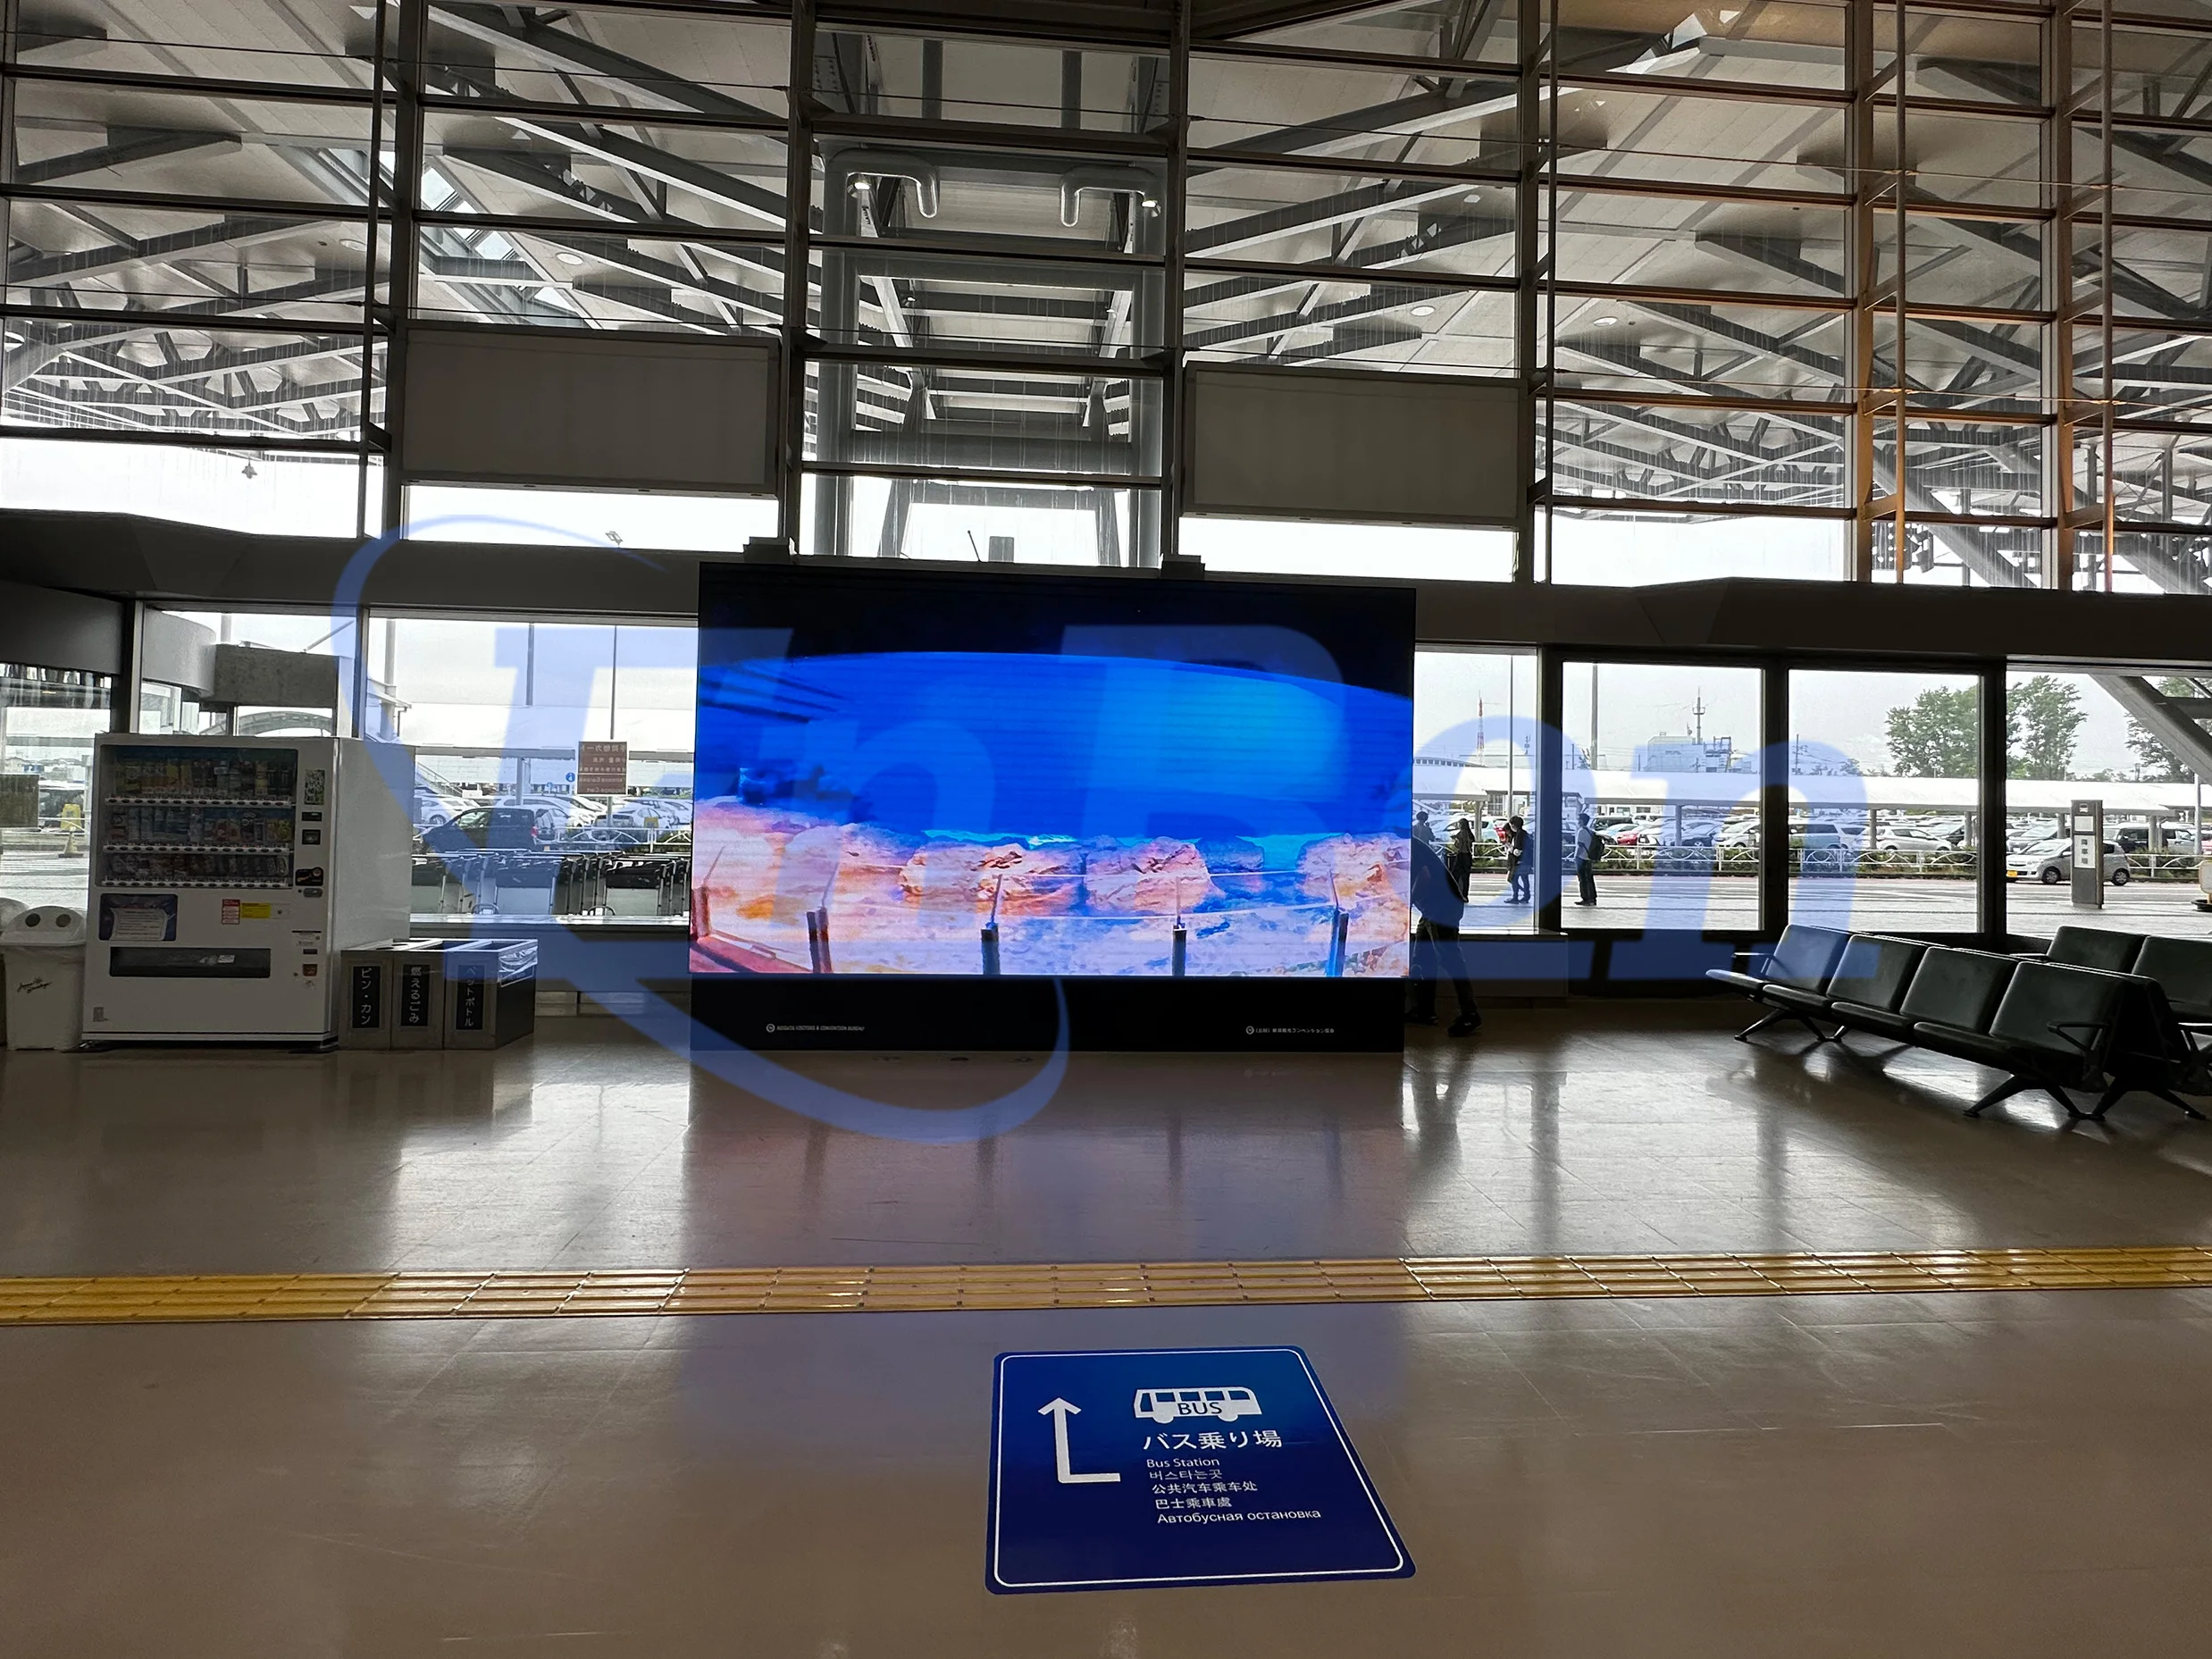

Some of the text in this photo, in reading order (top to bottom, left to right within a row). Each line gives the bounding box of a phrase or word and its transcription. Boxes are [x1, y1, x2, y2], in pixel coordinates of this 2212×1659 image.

[360, 968, 373, 1026] ビン・カン
[408, 966, 422, 1024] 燃えるごみ
[1177, 1401, 1223, 1416] BUS
[1143, 1429, 1283, 1450] バス乗り場
[1146, 1457, 1220, 1468] Bus Station
[1149, 1469, 1223, 1480] 버스타는곳
[1152, 1480, 1258, 1495] 公共汽车乘车处
[1157, 1510, 1321, 1524] Автобусная остановка
